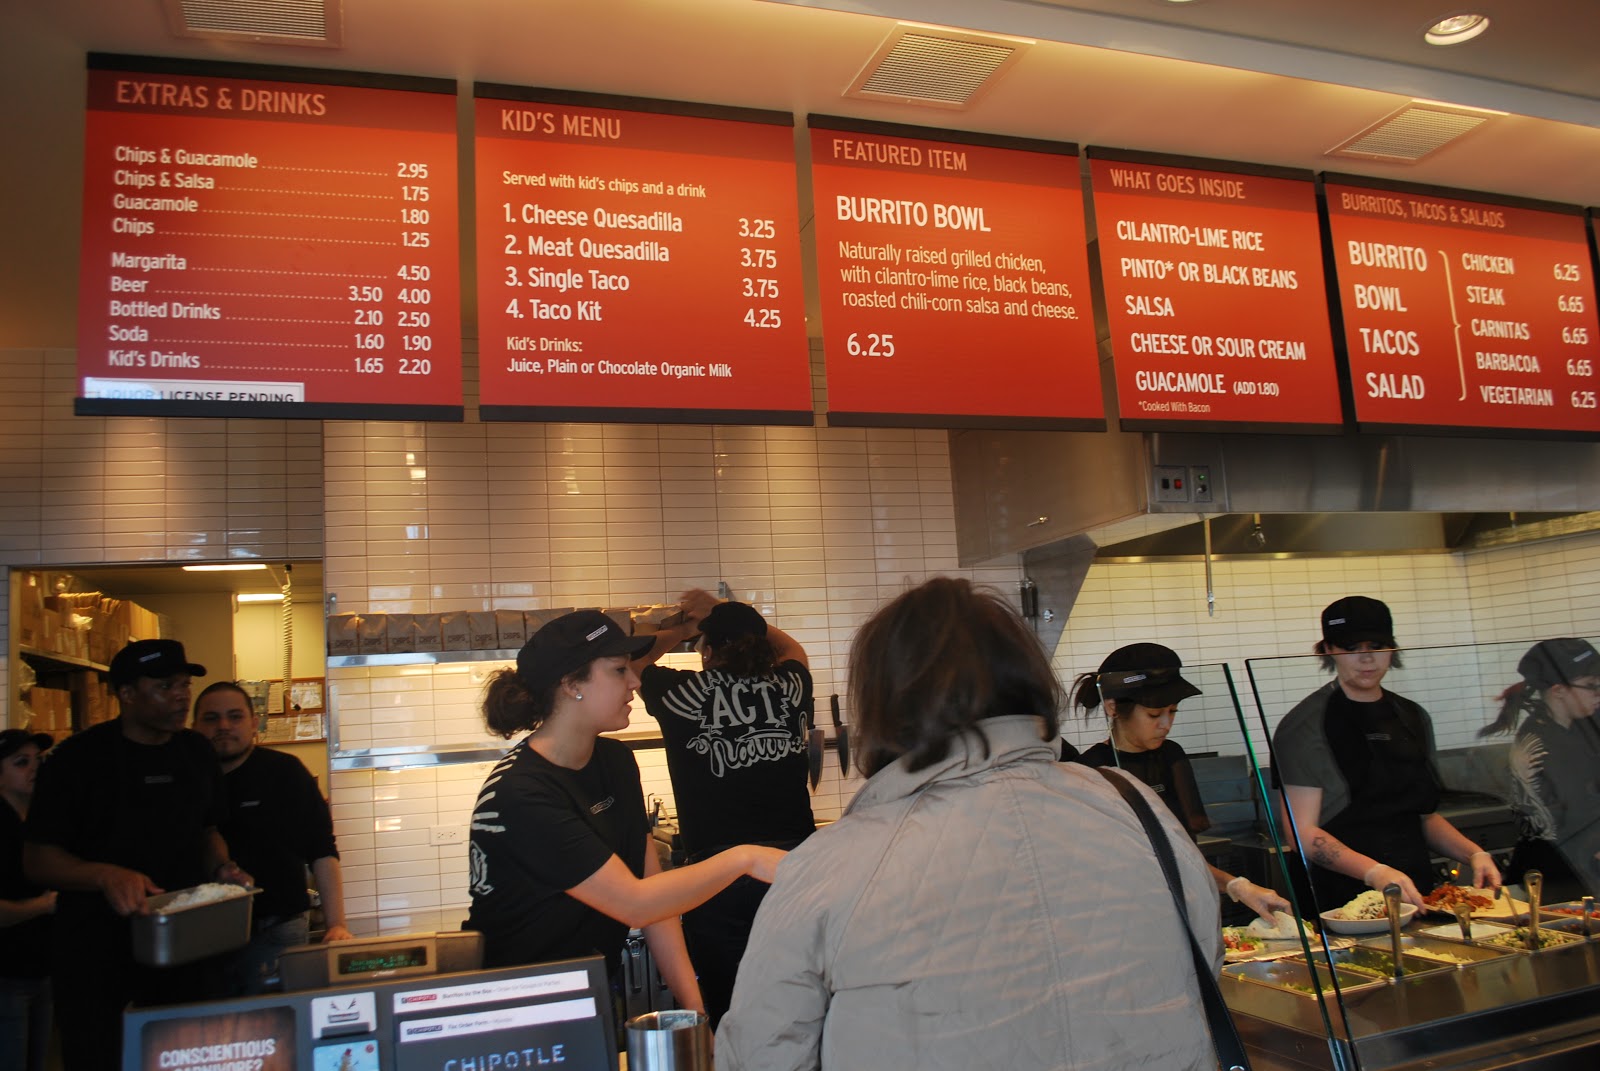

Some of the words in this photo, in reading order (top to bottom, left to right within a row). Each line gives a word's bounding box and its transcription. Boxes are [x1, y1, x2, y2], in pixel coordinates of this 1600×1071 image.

[116, 80, 208, 109] EXTRAS
[216, 88, 233, 111] &
[241, 89, 326, 116] DRINKS
[501, 109, 556, 134] KID'S
[562, 116, 621, 139] MENU
[115, 146, 156, 164] Chips
[160, 149, 172, 164] &
[175, 149, 258, 168] Guacamole
[397, 163, 428, 179] 2.95
[833, 138, 922, 166] FEATURED
[928, 150, 967, 171] ITEM
[114, 170, 155, 188] Chips
[159, 173, 171, 187] &
[174, 173, 215, 190] Salsa
[401, 186, 429, 202] 1.75
[503, 171, 546, 187] Served
[549, 175, 575, 189] with
[578, 176, 605, 191] kid's
[608, 178, 639, 193] chips
[642, 181, 663, 195] and
[667, 184, 674, 195] a
[677, 183, 706, 198] drink
[1110, 169, 1151, 189] WHAT
[1156, 173, 1195, 195] GOES
[1199, 178, 1245, 199] INSIDE
[113, 194, 198, 212] Guacamole
[401, 209, 429, 225] 1.80
[503, 203, 516, 223] 1.
[521, 204, 589, 226] Cheese
[593, 207, 683, 232] Quesadilla
[738, 218, 775, 239] 3.25
[836, 196, 928, 227] BURRITO
[933, 204, 991, 232] BOWL
[1342, 193, 1407, 218] BURRITOS,
[1410, 201, 1446, 222] TACOS
[1450, 206, 1459, 222] &
[1460, 208, 1505, 228] SALADS
[112, 218, 155, 236] Chips
[401, 232, 430, 248] 1.25
[1116, 220, 1229, 249] CILANTRO-LIME
[1232, 230, 1264, 251] RICE
[504, 235, 522, 255] 2.
[528, 236, 574, 258] Meat
[579, 238, 670, 262] Quesadilla
[740, 248, 777, 269] 3.75
[839, 241, 902, 265] Naturally
[906, 246, 947, 264] raised
[951, 249, 992, 269] grilled
[994, 252, 1046, 274] chicken,
[1348, 241, 1427, 272] BURRITO
[1462, 253, 1514, 274] CHICKEN
[112, 252, 187, 272] Margarita
[397, 265, 430, 282] 4.50
[1178, 262, 1200, 282] OR
[1203, 264, 1249, 285] BLACK
[1252, 268, 1298, 290] BEANS
[1553, 263, 1580, 282] 6.25
[111, 276, 148, 292] Beer
[348, 286, 383, 302] 3.50
[398, 288, 431, 305] 4.00
[505, 266, 523, 287] 3.
[528, 267, 583, 293] Single
[589, 269, 630, 291] Taco
[742, 278, 779, 298] 3.75
[840, 266, 871, 284] with
[874, 268, 959, 288] cilantro-lime
[963, 273, 991, 293] rice,
[994, 275, 1028, 293] black
[1031, 278, 1072, 298] beans,
[1466, 286, 1505, 305] STEAK
[842, 290, 896, 308] roasted
[900, 293, 962, 312] chili-corn
[966, 296, 1000, 314] salsa
[1003, 300, 1028, 316] and
[1031, 301, 1079, 320] cheese.
[1125, 295, 1174, 317] SALSA
[1354, 284, 1408, 312] BOWL
[1558, 295, 1584, 313] 6.65
[110, 301, 168, 318] Bottled
[172, 303, 221, 320] Drinks
[354, 310, 383, 325] 2.10
[398, 312, 431, 328] 2.50
[506, 298, 524, 319] 4.
[529, 299, 571, 321] Taco
[577, 300, 602, 321] Kit
[743, 308, 781, 329] 4.25
[109, 325, 148, 342] Soda
[354, 333, 384, 349] 1.60
[402, 335, 432, 351] 1.90
[1359, 328, 1420, 356] TACOS
[1471, 319, 1530, 340] CARNITAS
[1562, 327, 1588, 344] 6.65
[506, 336, 537, 352] Kid's
[540, 338, 583, 353] Drinks:
[847, 333, 895, 358] 6.25
[1131, 333, 1189, 354] CHEESE
[1191, 336, 1213, 355] OR
[1216, 337, 1255, 358] SOUR
[1258, 339, 1306, 360] CREAM
[108, 350, 146, 367] Kid's
[151, 351, 200, 368] Drinks
[354, 358, 384, 373] 1.65
[398, 359, 431, 375] 2.20
[507, 358, 544, 375] Juice,
[547, 359, 577, 374] Plain
[580, 363, 594, 375] or
[597, 360, 658, 376] Chocolate
[660, 362, 705, 379] Organic
[709, 363, 732, 378] Milk
[1476, 352, 1540, 373] BARBACOA
[1567, 359, 1593, 377] 6.65
[1136, 371, 1226, 394] GUACAMOLE
[1233, 381, 1256, 395] (ADD
[1258, 382, 1279, 396] 1.80)
[1366, 372, 1425, 400] SALAD
[1480, 385, 1554, 406] VEGETARIAN
[1172, 402, 1187, 412] With
[1188, 402, 1210, 413] Bacon
[1571, 391, 1597, 409] 6.25
[711, 681, 780, 729] ACT
[160, 1038, 276, 1068] CONSCIENTIOUS
